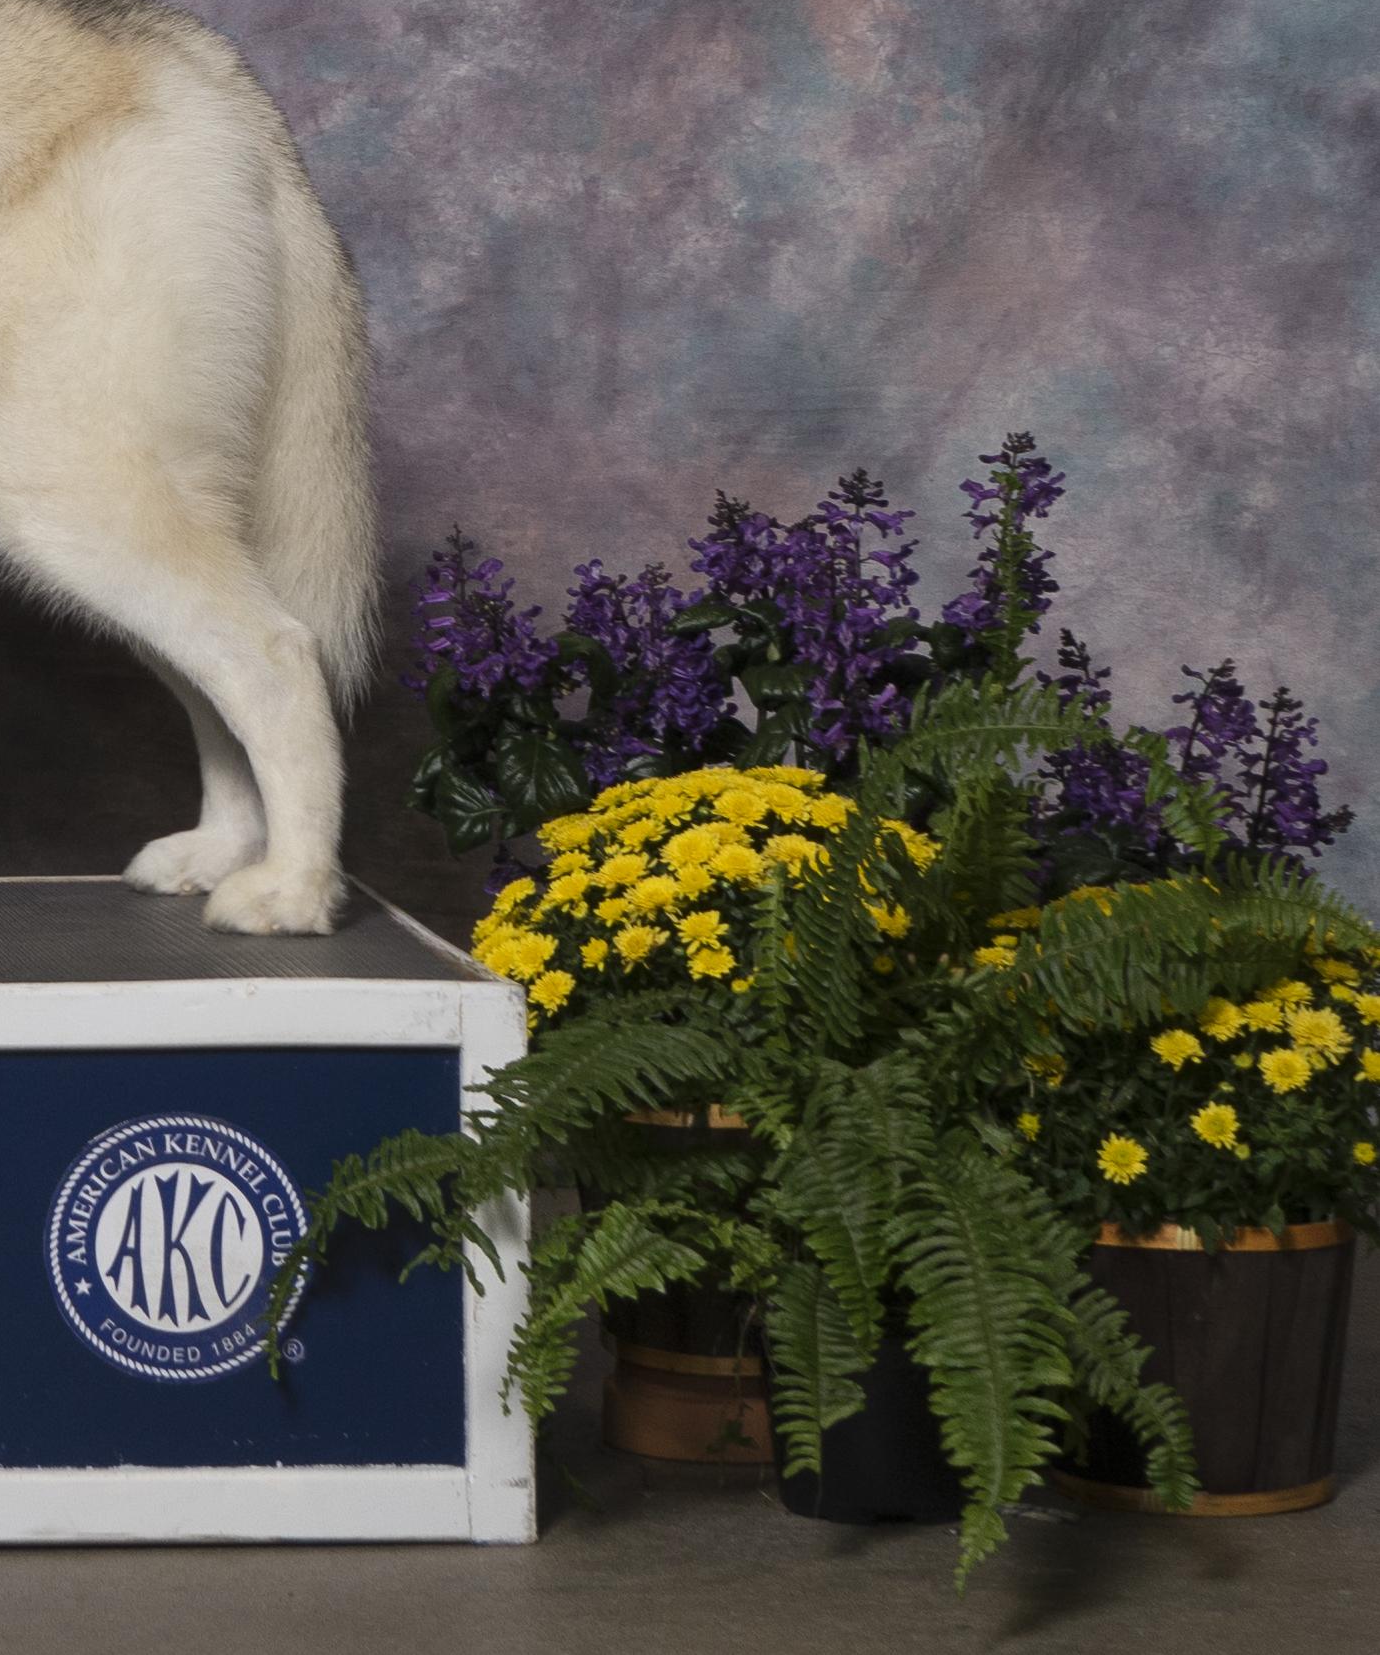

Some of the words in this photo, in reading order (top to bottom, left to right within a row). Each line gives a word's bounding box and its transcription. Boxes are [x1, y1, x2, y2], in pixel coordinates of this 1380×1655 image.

[66, 1135, 157, 1266] AMERICAN
[163, 1132, 269, 1195] KENNEL
[105, 1169, 251, 1328] AKC
[99, 1317, 201, 1364] FOUNDED
[210, 1322, 257, 1358] 1884
